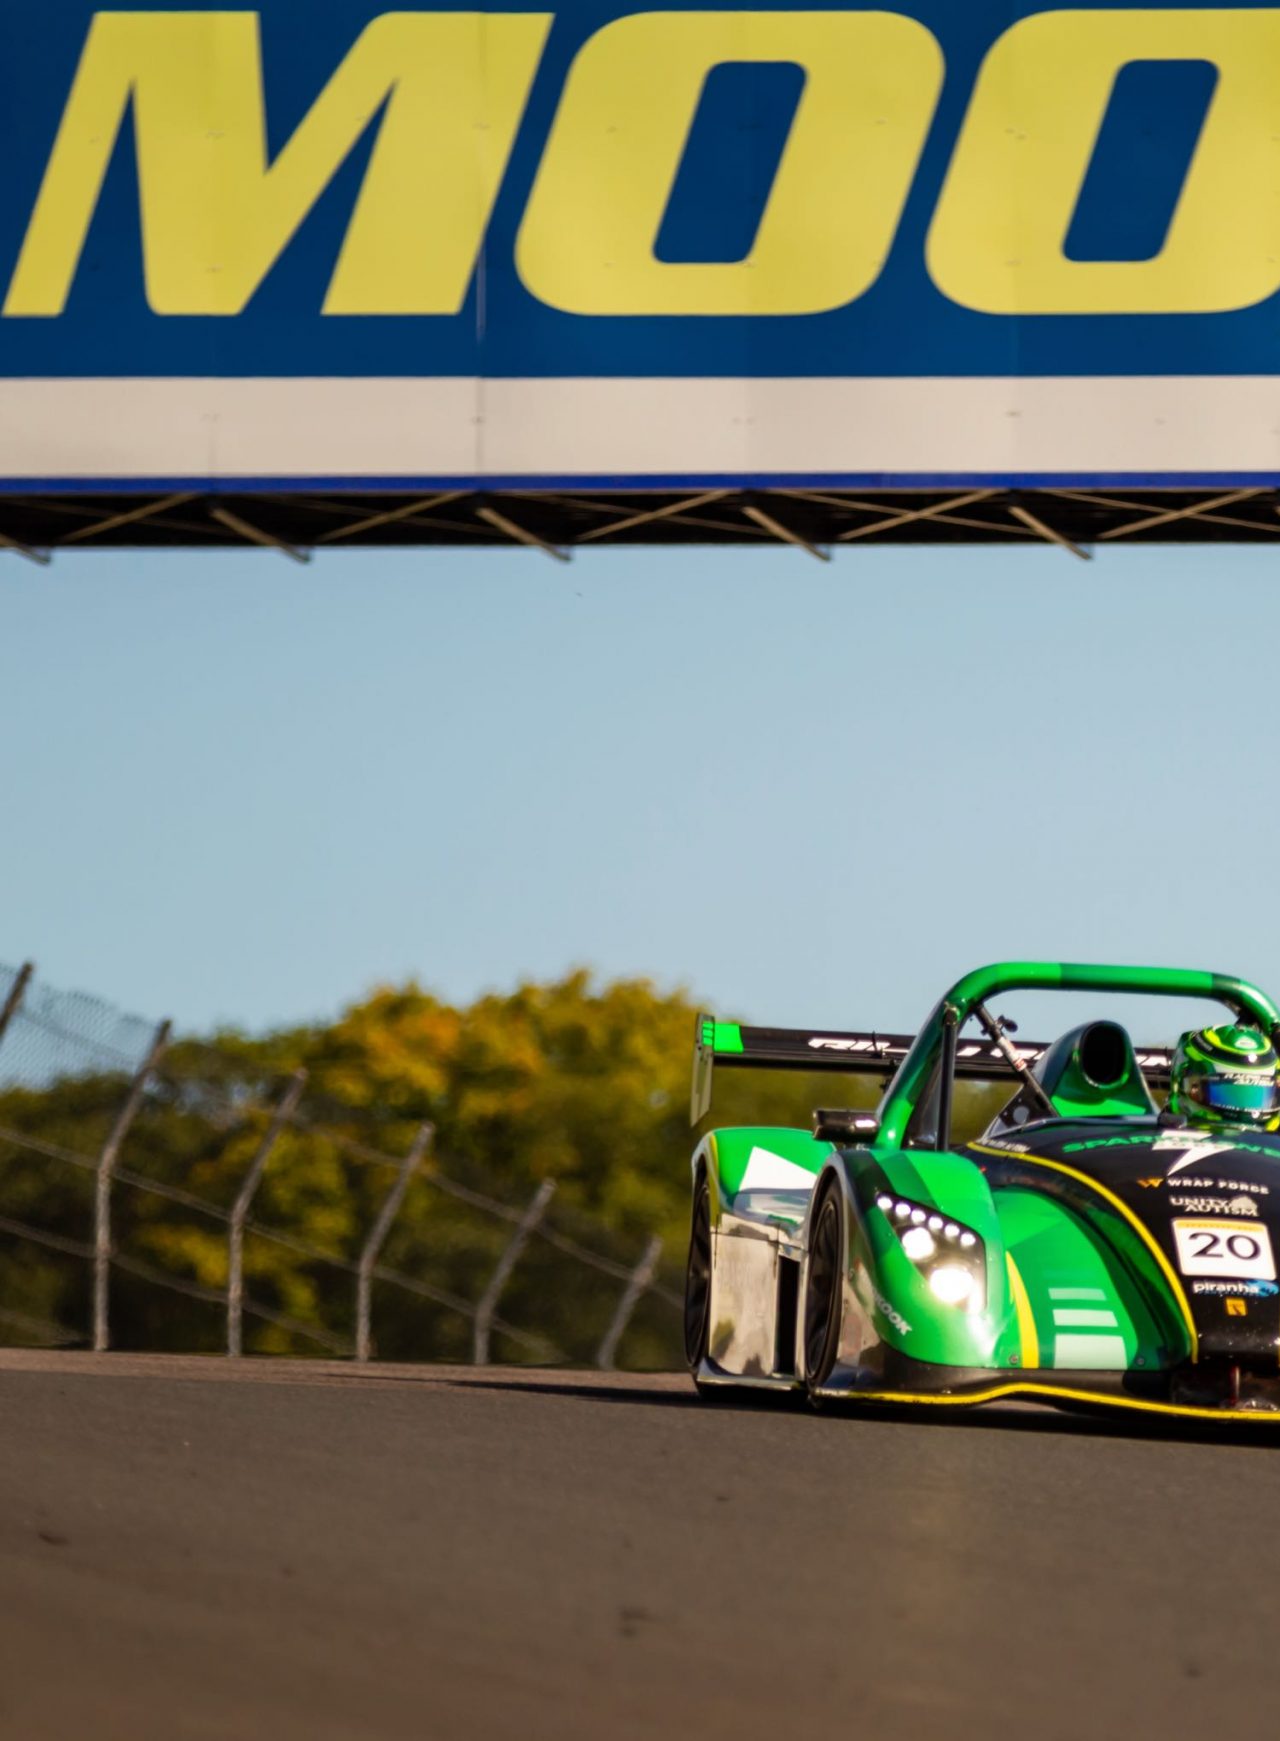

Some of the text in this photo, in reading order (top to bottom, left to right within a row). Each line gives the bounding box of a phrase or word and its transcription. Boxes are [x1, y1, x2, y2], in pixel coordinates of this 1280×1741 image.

[1167, 1178, 1215, 1188] WRAP
[1217, 1180, 1270, 1195] FORCE
[1169, 1195, 1229, 1208] UNITY
[1184, 1204, 1258, 1217] AUTISM
[1188, 1231, 1261, 1261] 20
[1192, 1280, 1260, 1295] piranha
